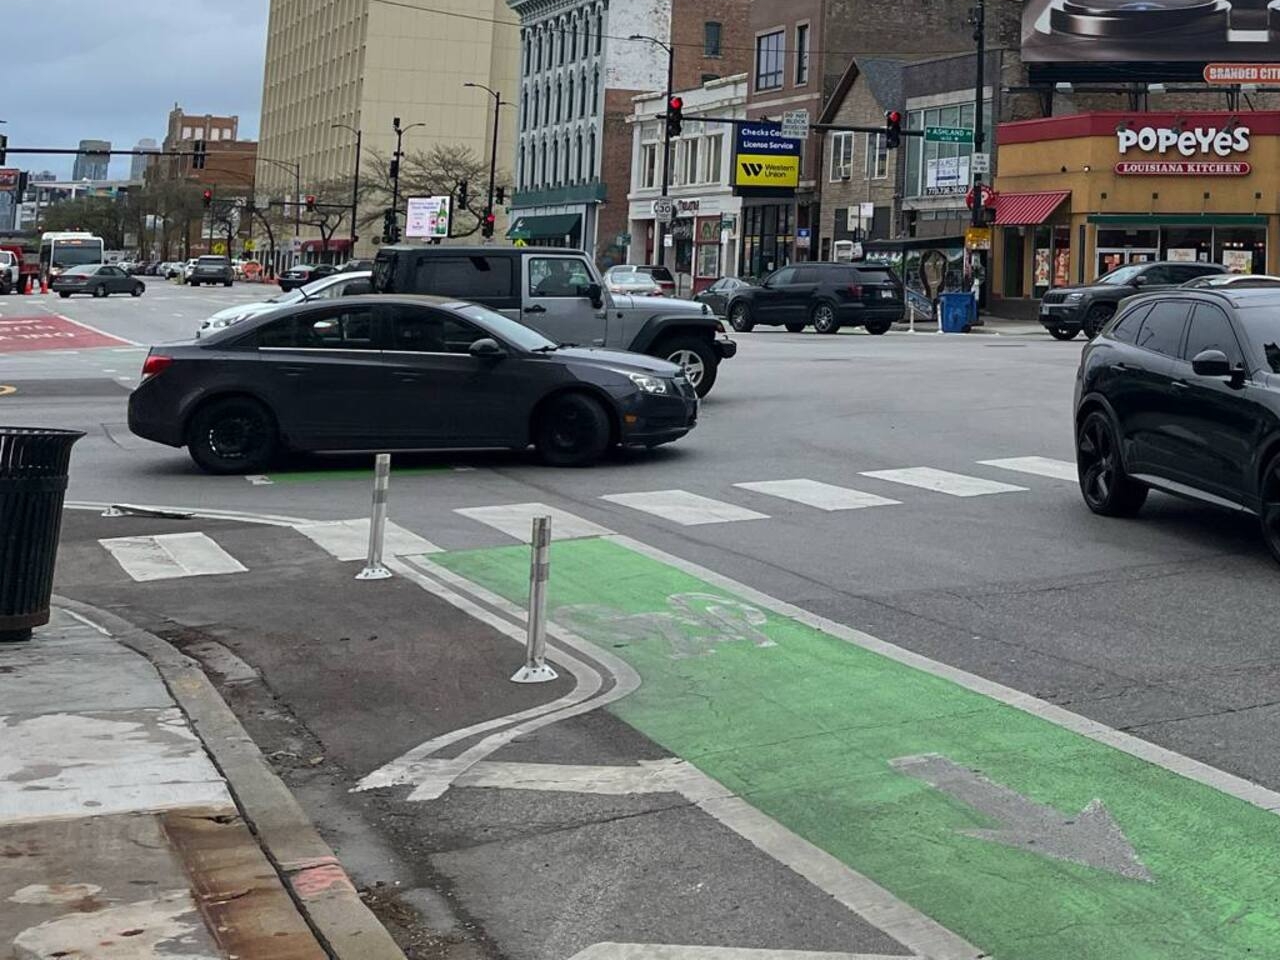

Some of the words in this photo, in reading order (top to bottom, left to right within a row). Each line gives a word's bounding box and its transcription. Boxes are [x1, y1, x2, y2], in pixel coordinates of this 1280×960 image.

[1210, 68, 1258, 79] BRANDED
[741, 128, 769, 136] Checks
[932, 128, 965, 136] ASHLAND
[743, 141, 769, 149] License
[769, 142, 794, 150] Service
[764, 163, 795, 171] Western
[1123, 164, 1184, 172] LOUISIANA
[1186, 164, 1241, 172] KITCHEN
[764, 170, 787, 178] Union
